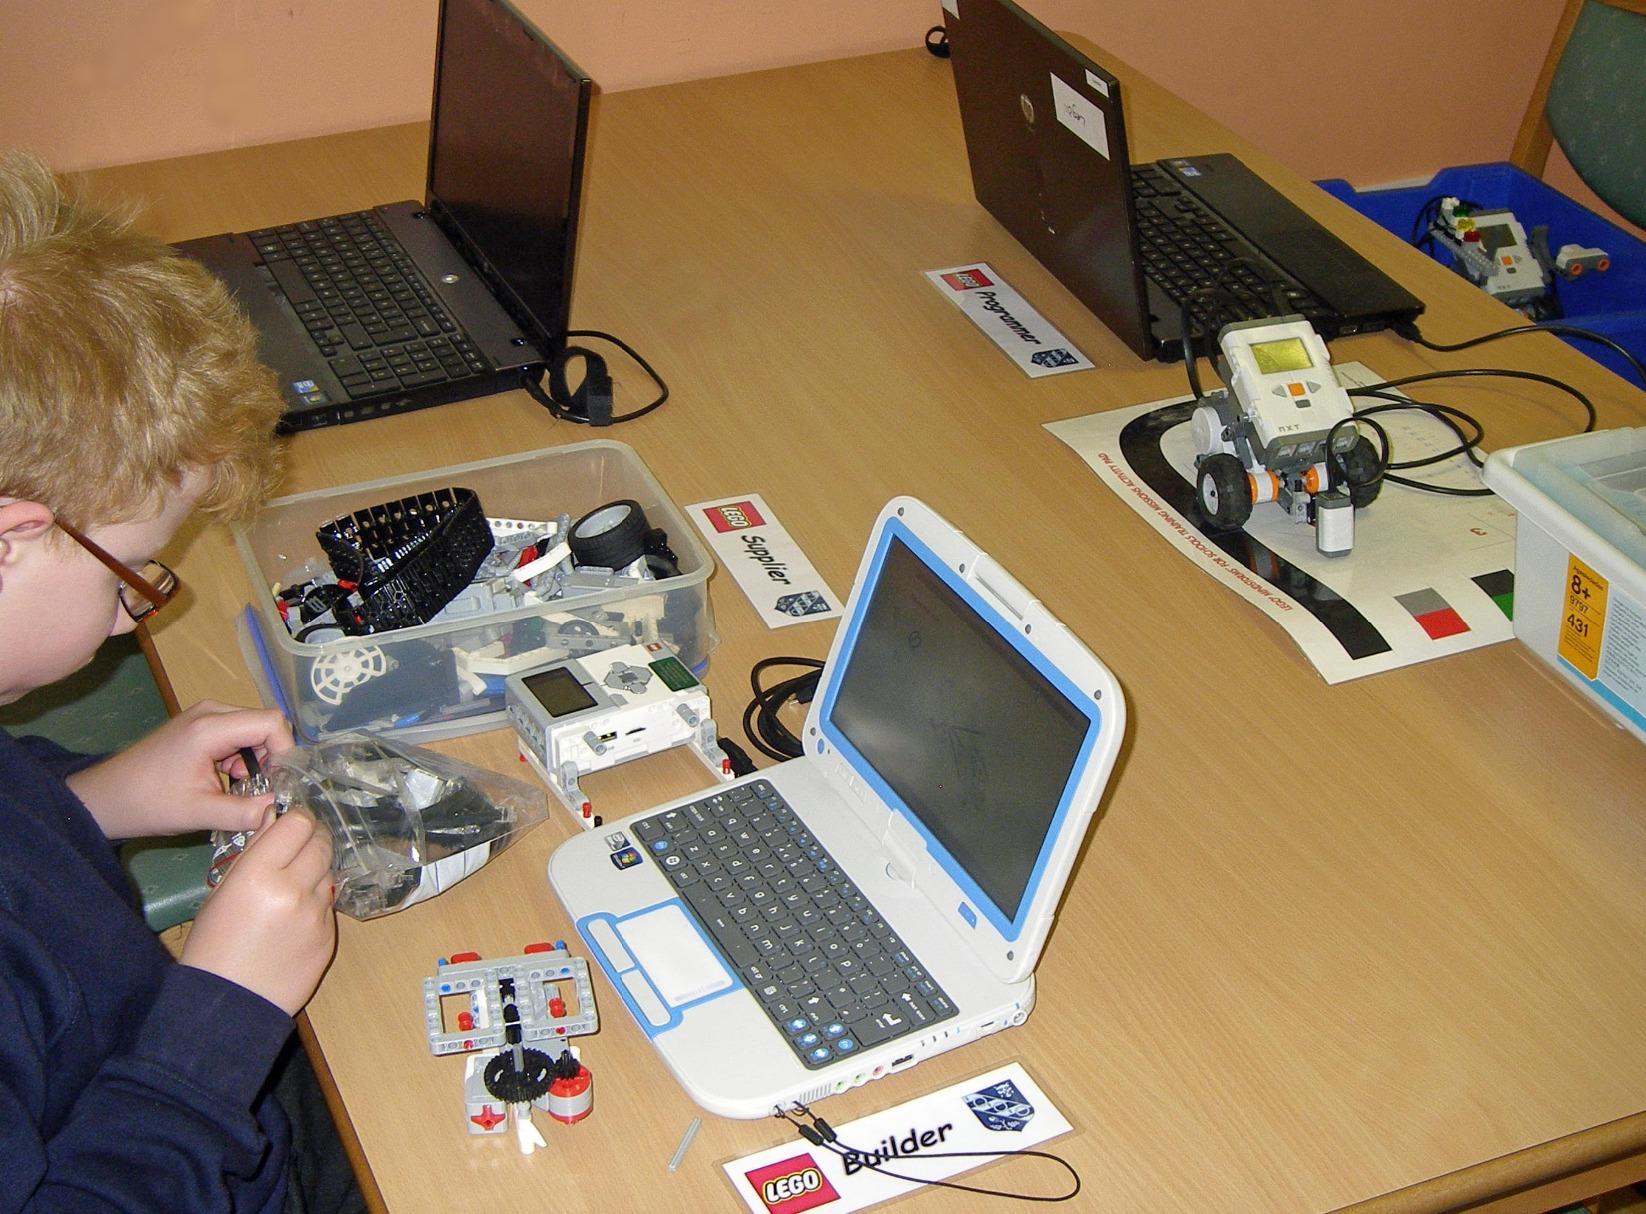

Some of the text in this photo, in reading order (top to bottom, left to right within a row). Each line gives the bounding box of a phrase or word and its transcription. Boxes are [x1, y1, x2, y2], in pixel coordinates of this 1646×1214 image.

[956, 273, 979, 288] LEGO
[975, 291, 1041, 345] Programmer
[1098, 452, 1113, 469] PAD
[720, 506, 750, 528] LEGO
[1158, 510, 1189, 539] TRAINING
[741, 535, 791, 585] Supplier
[1186, 534, 1217, 561] SCHOOLS
[1214, 557, 1229, 571] FOR
[1571, 574, 1591, 599] 8+
[1567, 613, 1589, 638] 431
[842, 1122, 953, 1176] Builder
[765, 1169, 821, 1203] LEGO
